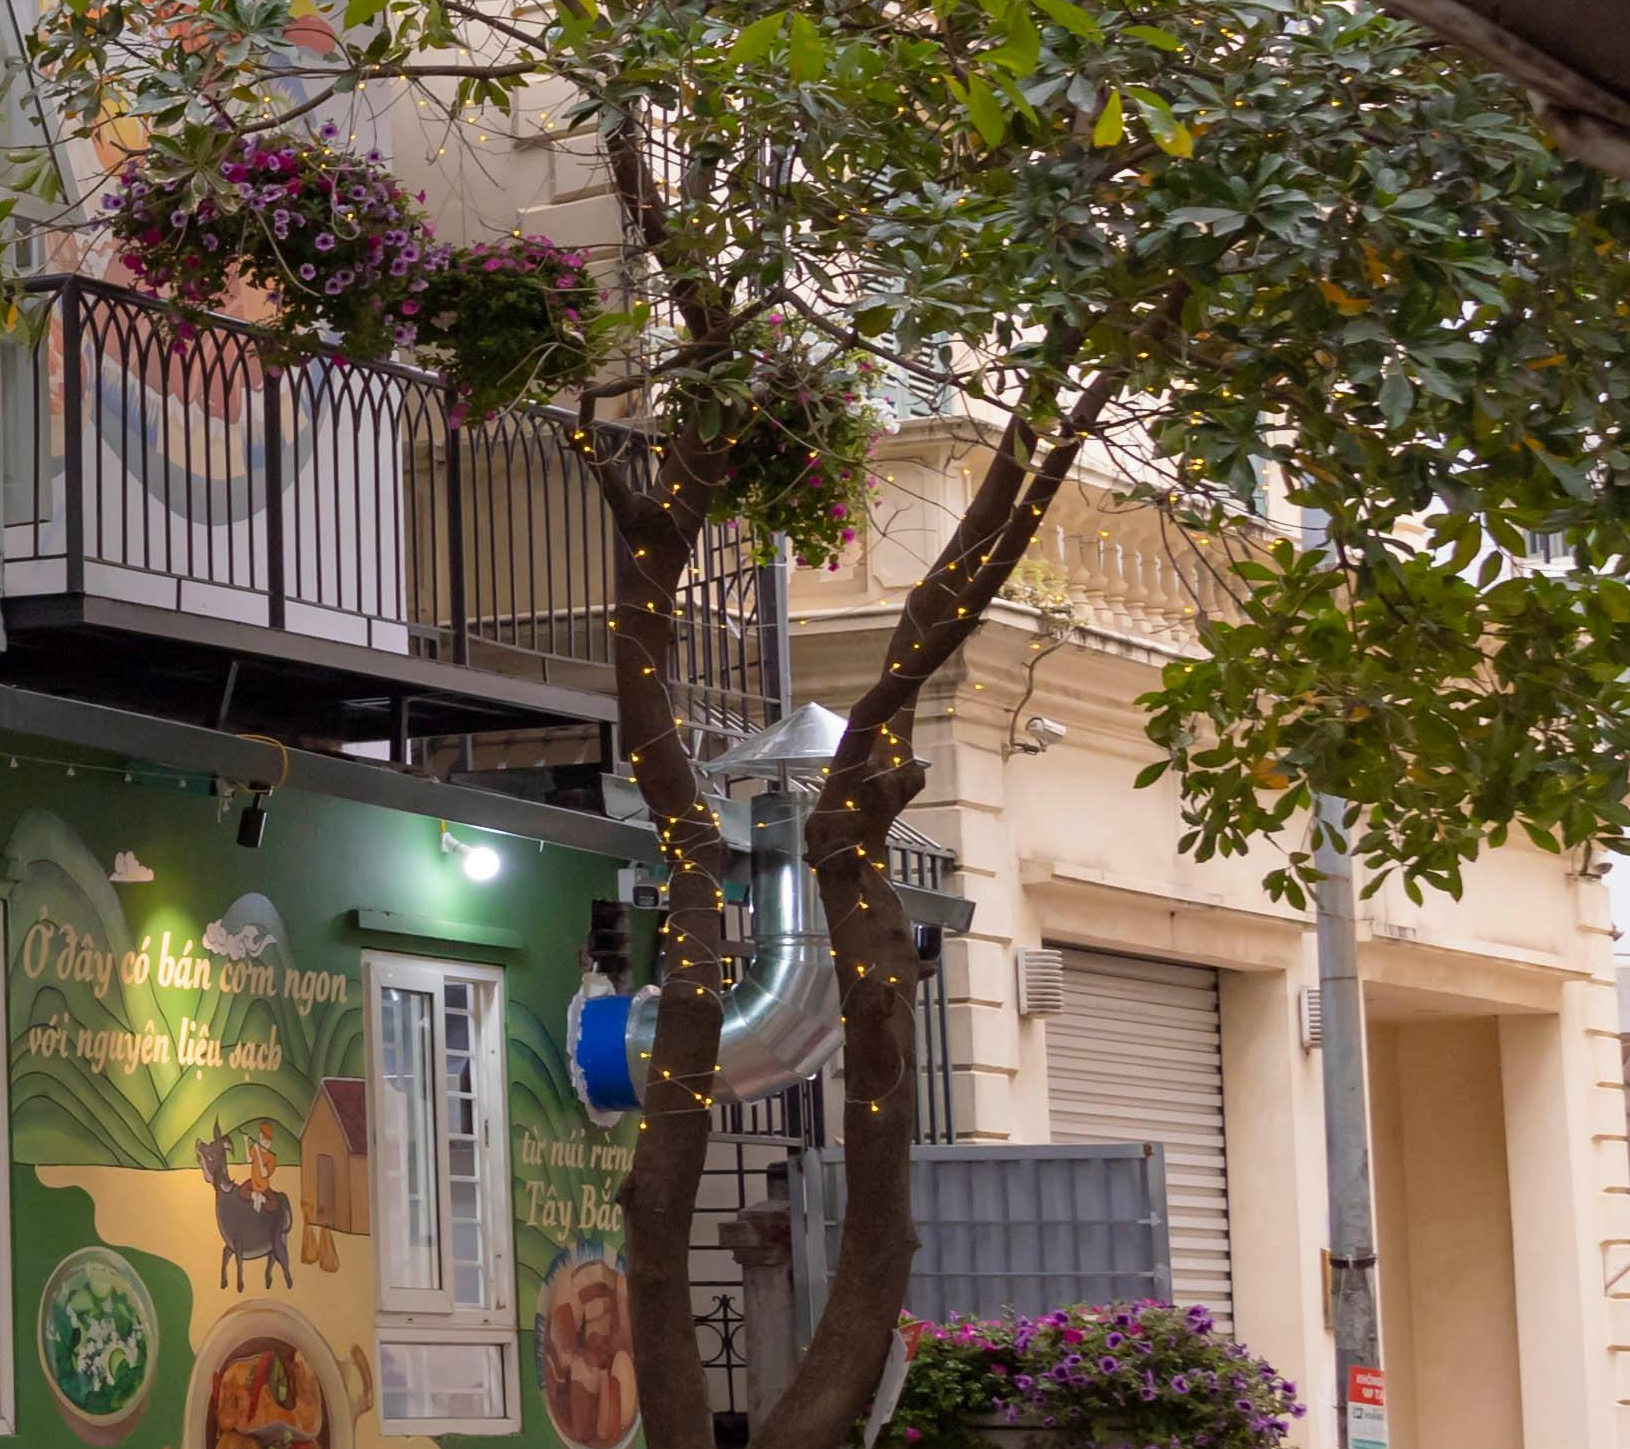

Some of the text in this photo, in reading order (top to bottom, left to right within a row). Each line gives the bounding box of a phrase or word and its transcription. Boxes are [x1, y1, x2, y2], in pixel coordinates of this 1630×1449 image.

[120, 935, 151, 985] có
[158, 931, 212, 990] bán
[219, 957, 277, 997] cơm
[283, 964, 348, 1016] ngon
[28, 1012, 68, 1058] với
[77, 1020, 170, 1075] nguyên
[177, 1017, 222, 1080] liệu
[525, 1176, 622, 1241] Tây Bắc
